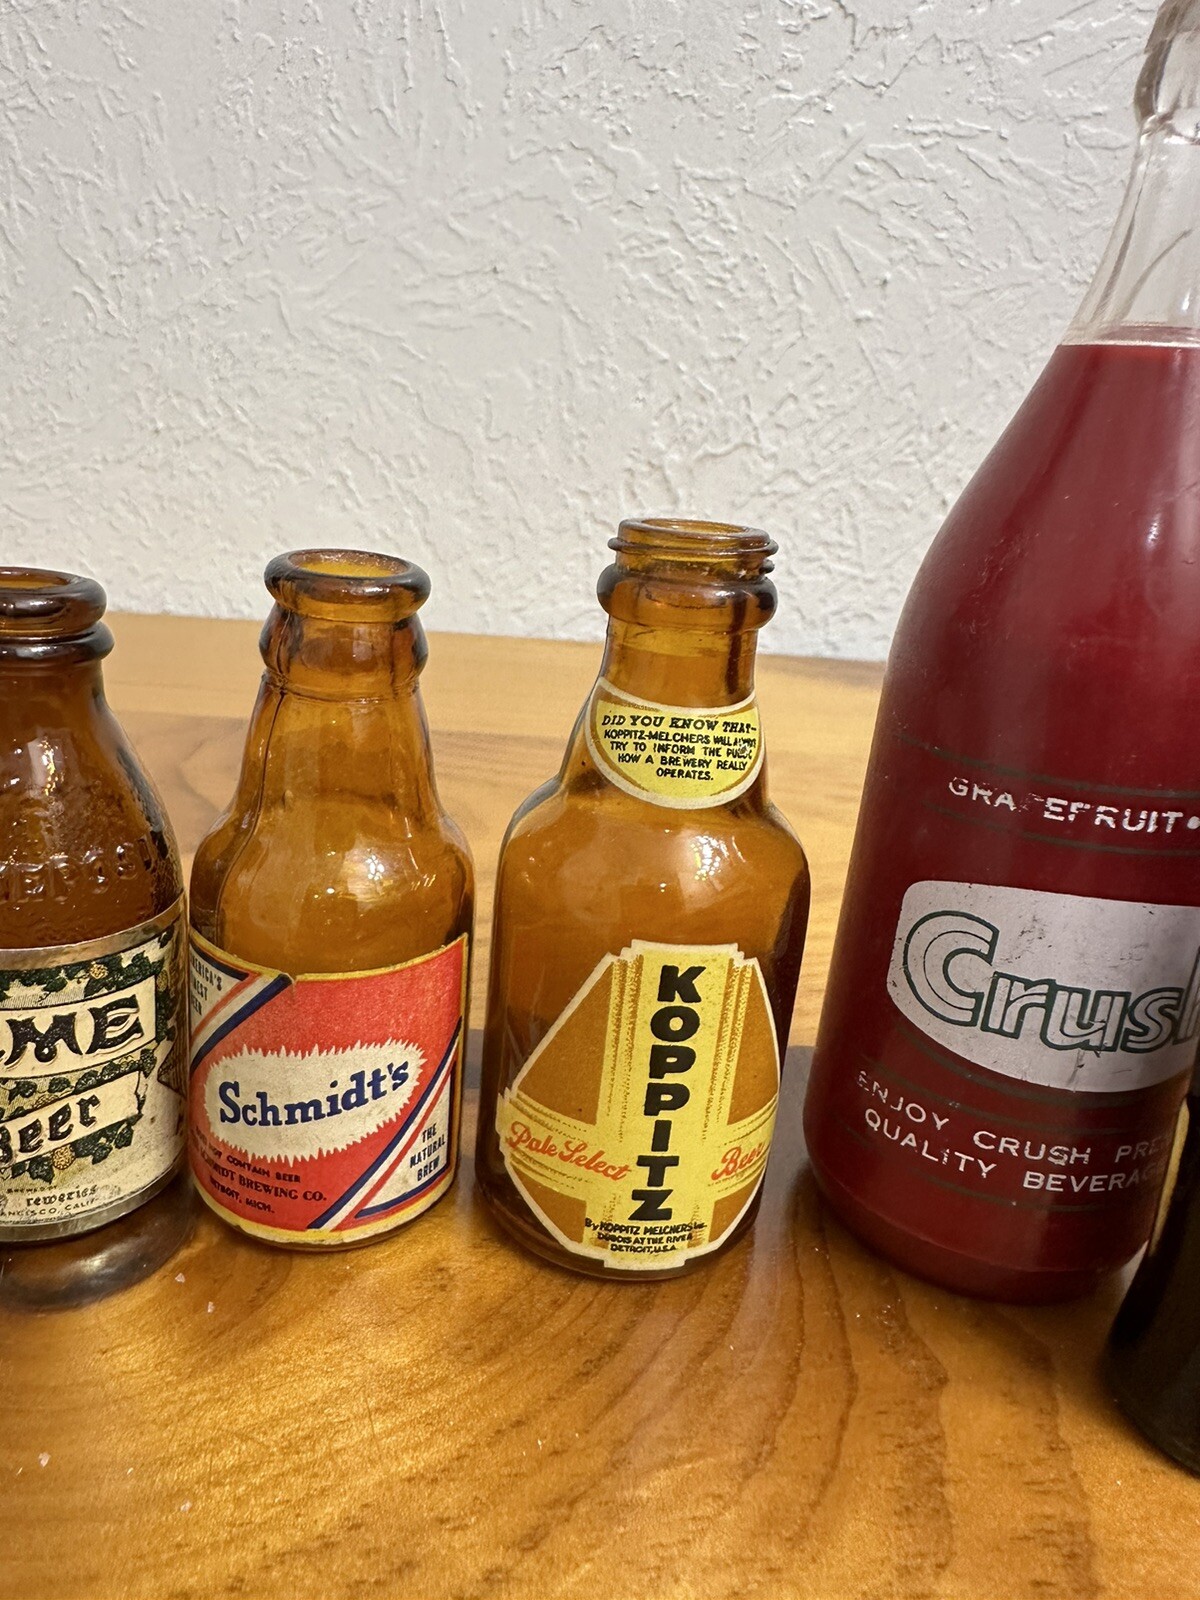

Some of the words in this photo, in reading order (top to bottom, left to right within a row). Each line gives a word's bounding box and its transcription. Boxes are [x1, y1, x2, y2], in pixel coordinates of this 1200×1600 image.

[602, 715, 626, 726] DID
[630, 715, 665, 727] YOU
[669, 717, 719, 731] KNOW
[604, 729, 711, 745] KOPPITZ-MELCHERS
[713, 735, 732, 746] WILL
[610, 742, 628, 751] TRY
[633, 742, 646, 752] TO
[653, 743, 695, 755] INFORM
[703, 746, 722, 757] THE
[618, 753, 641, 763] HOW
[645, 755, 654, 764] A
[660, 755, 712, 769] BREWERY
[716, 760, 748, 771] REALLY
[656, 767, 714, 781] OPERATES.
[949, 777, 1183, 833] GRAEFRUIT
[0, 994, 144, 1065] ME
[218, 1061, 409, 1127] Schmidt's
[627, 965, 706, 1221] KOPPITZ
[856, 1070, 949, 1131] ENJOY
[973, 1130, 1091, 1165] CRUSH
[422, 1123, 437, 1143] THE
[865, 1108, 996, 1178] QUALITY
[410, 1134, 445, 1168] NATURAL
[506, 1121, 559, 1158] Pale
[557, 1140, 632, 1181] Select
[226, 1155, 271, 1178] CONTAIN
[275, 1171, 301, 1184] BEER
[418, 1155, 440, 1181] BREW
[239, 1174, 298, 1200] BREWING
[303, 1190, 327, 1201] CO.
[599, 1221, 641, 1235] KOPPITZ
[643, 1223, 693, 1236] MELCHERS
[632, 1237, 645, 1245] AT
[645, 1235, 665, 1245] THE
